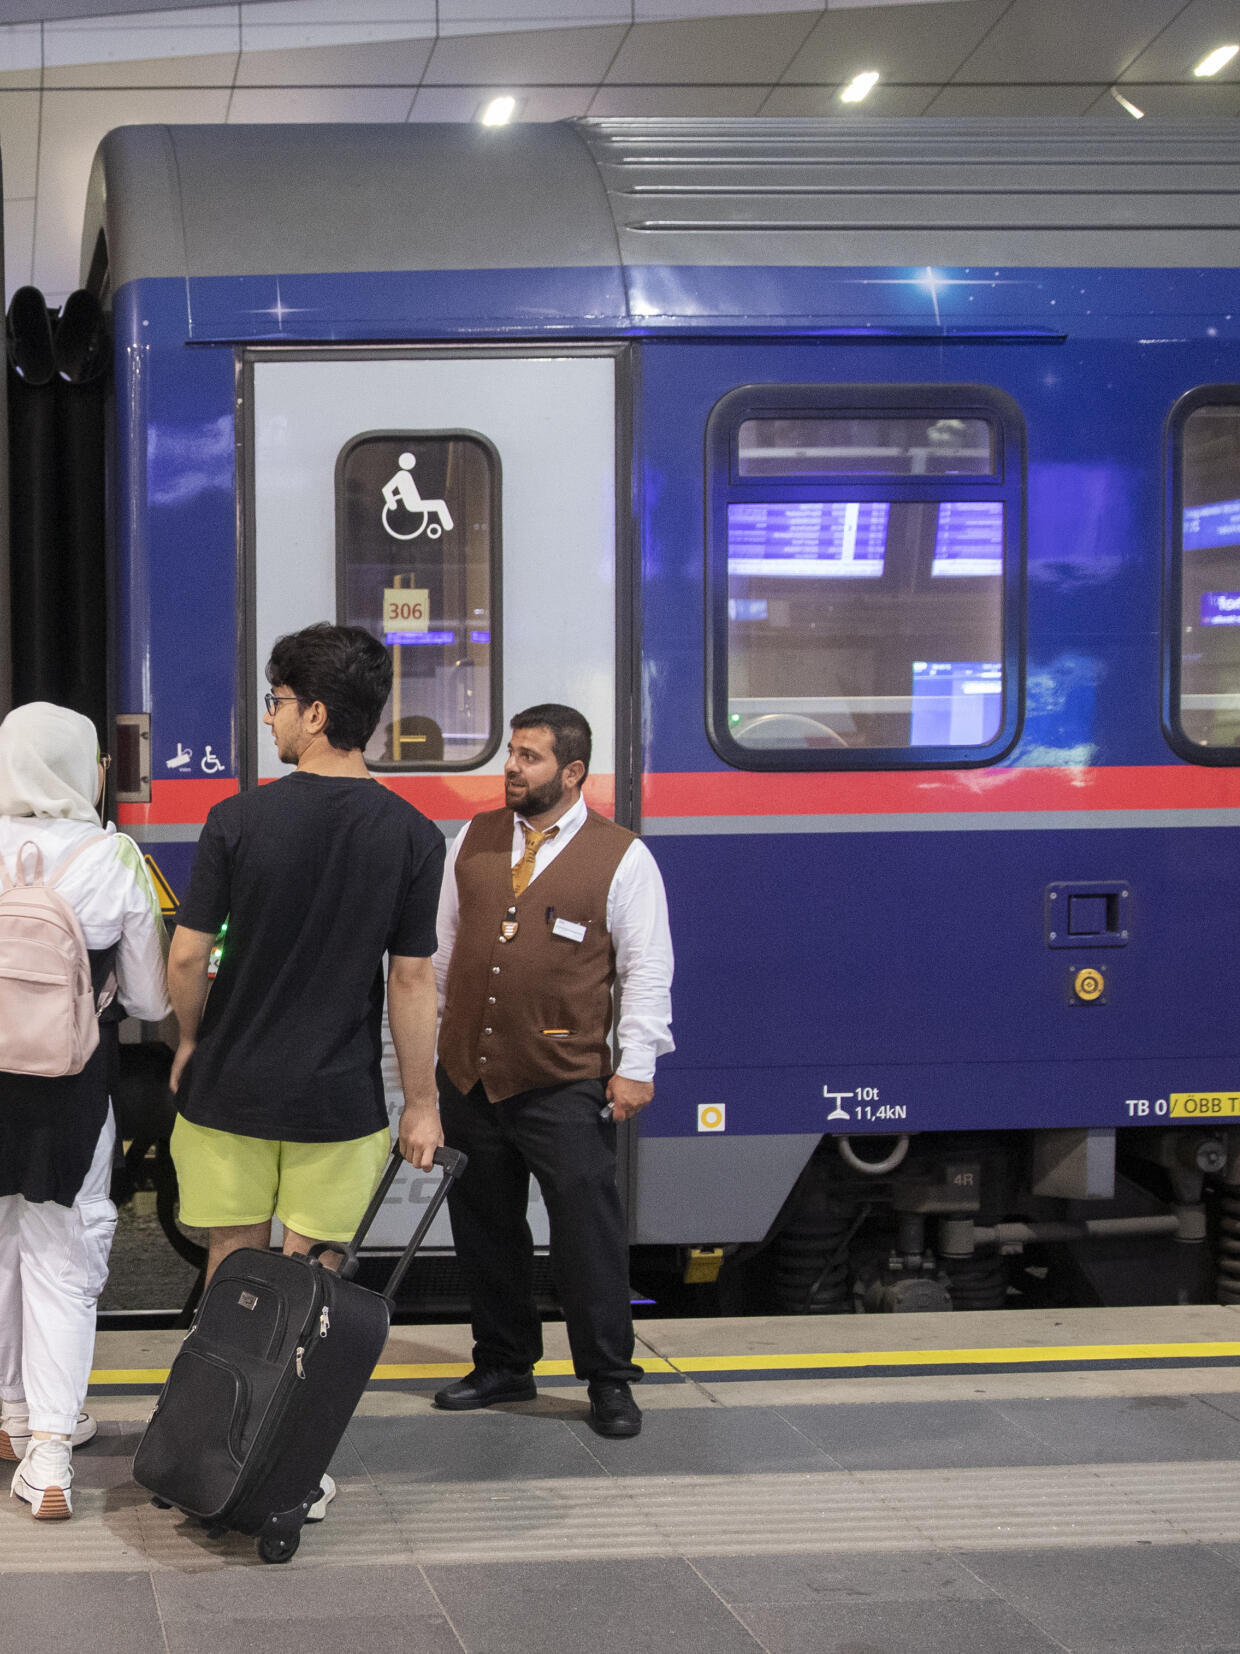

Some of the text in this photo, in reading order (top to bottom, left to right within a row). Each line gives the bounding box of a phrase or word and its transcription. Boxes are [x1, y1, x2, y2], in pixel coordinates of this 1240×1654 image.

[388, 602, 423, 620] 306
[855, 1087, 879, 1101] 10t
[855, 1105, 907, 1122] 11,4kN
[1125, 1099, 1150, 1116] TB
[1183, 1094, 1222, 1114] ÖBB
[1227, 1097, 1240, 1113] T
